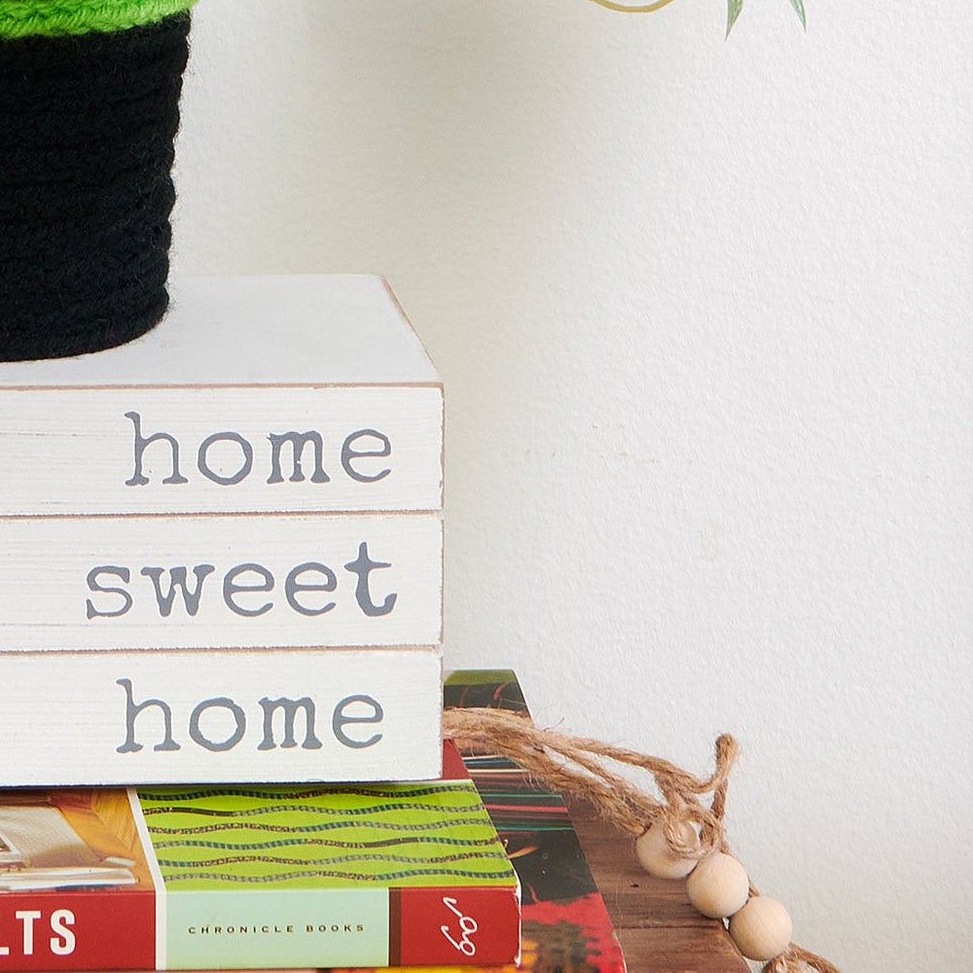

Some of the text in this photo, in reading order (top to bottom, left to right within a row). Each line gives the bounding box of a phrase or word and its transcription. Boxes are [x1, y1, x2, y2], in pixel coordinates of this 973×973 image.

[124, 411, 392, 487] home
[85, 541, 398, 620] sweet
[116, 678, 384, 754] home
[188, 924, 365, 934] CHRONICLE BOOKS
